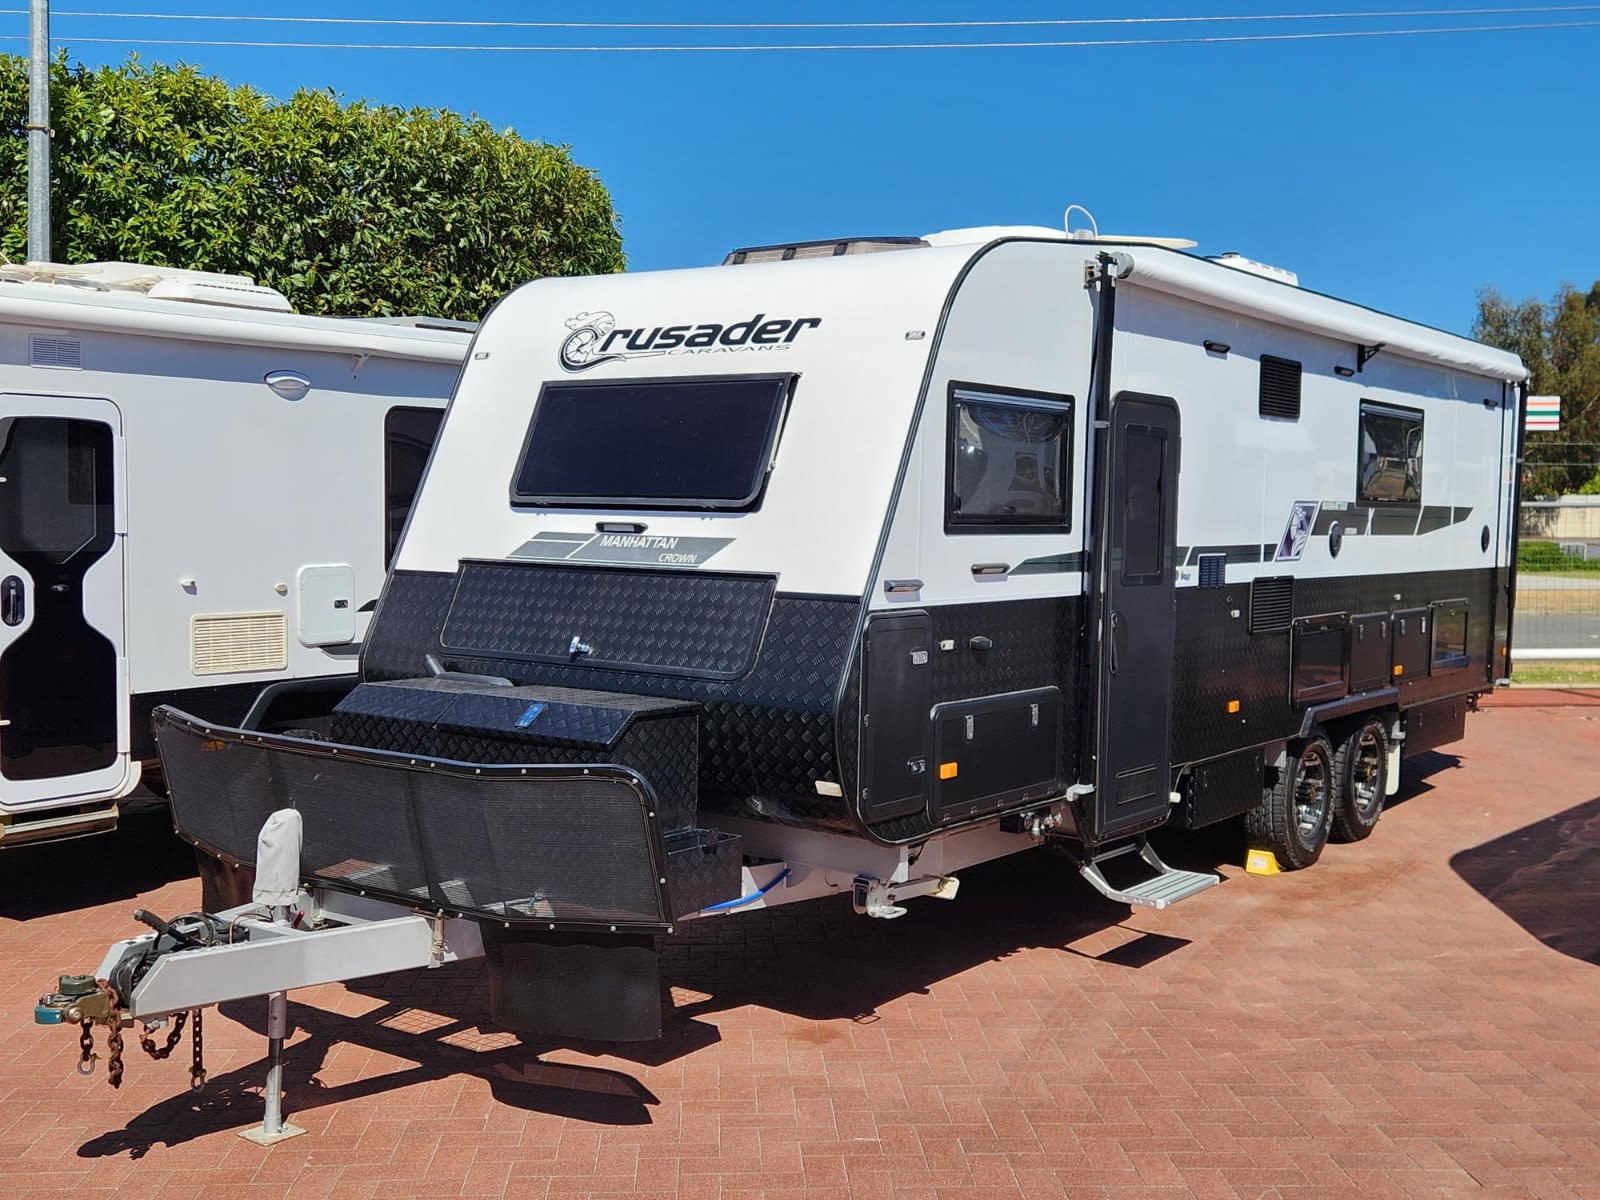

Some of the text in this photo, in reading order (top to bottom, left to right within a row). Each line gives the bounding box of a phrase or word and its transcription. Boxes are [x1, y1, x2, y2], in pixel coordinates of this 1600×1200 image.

[558, 313, 822, 373] Crusader
[667, 344, 791, 356] CARAVANS
[599, 535, 680, 550] MANHATTAN
[658, 553, 698, 564] CROWN
